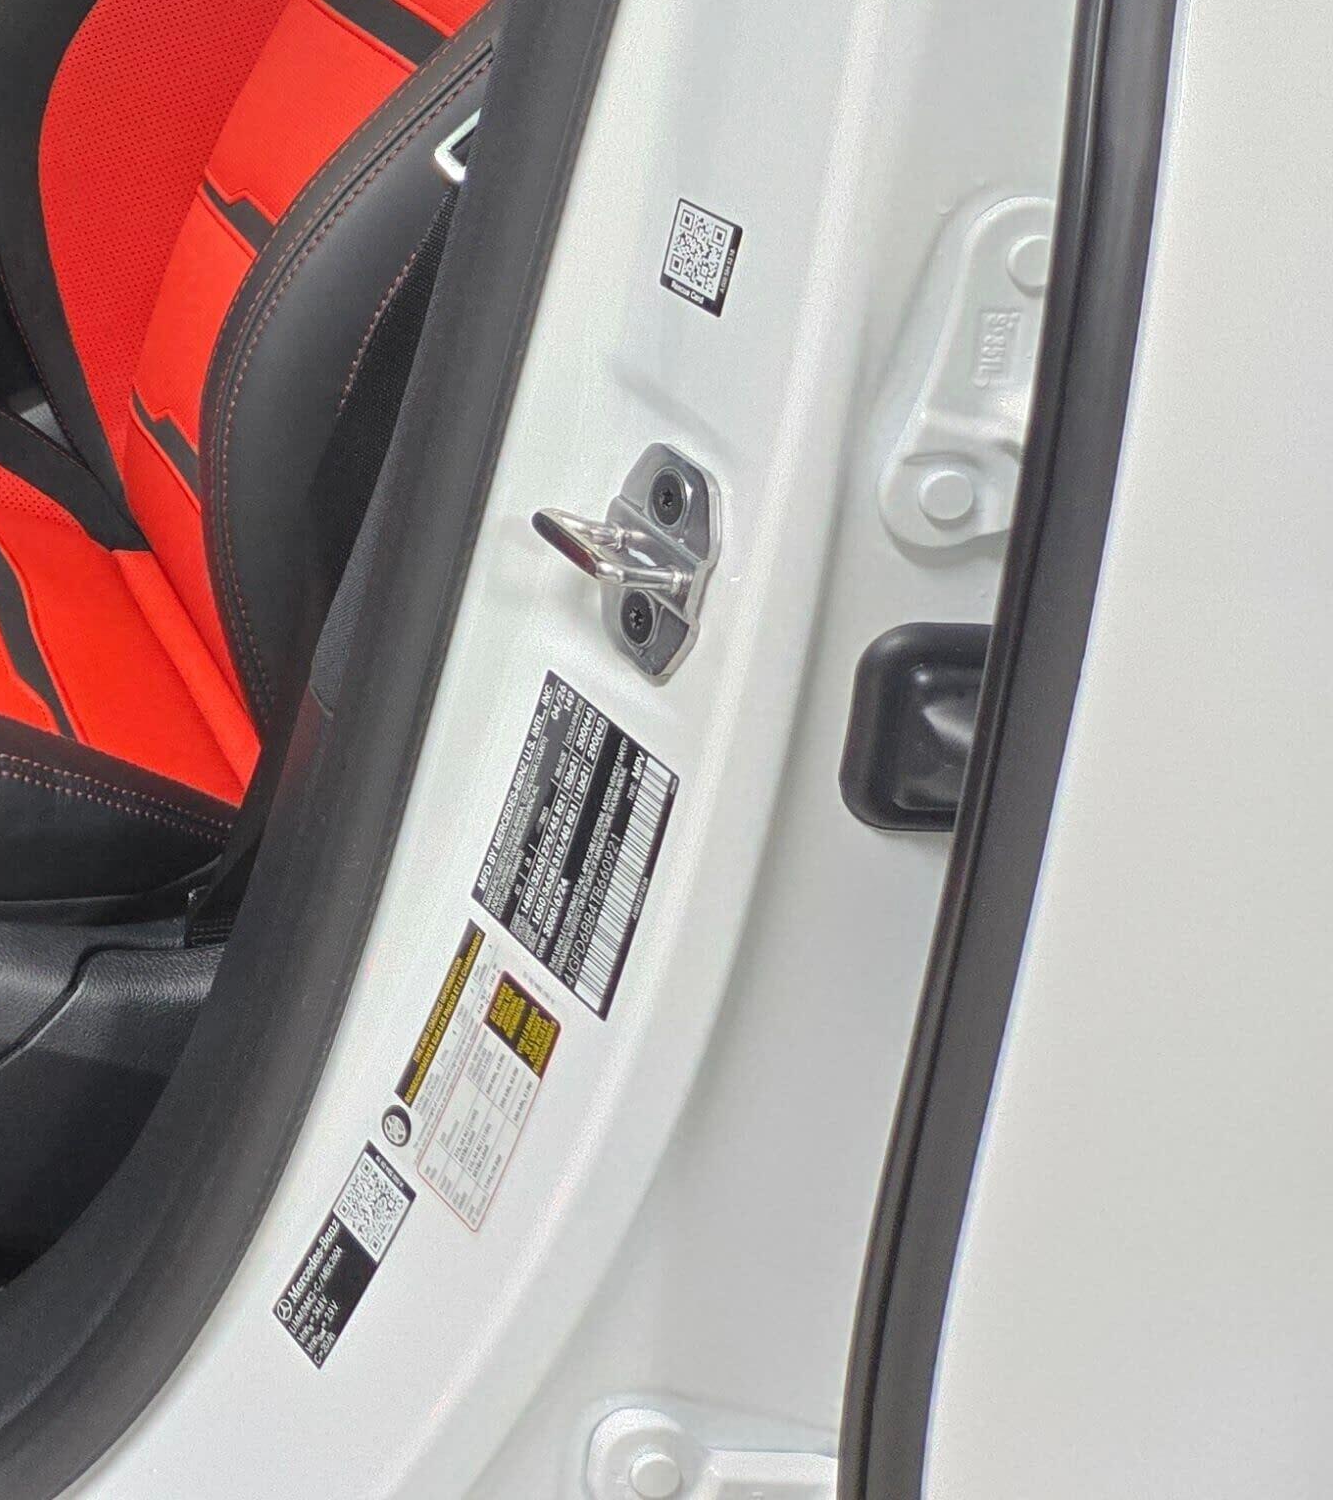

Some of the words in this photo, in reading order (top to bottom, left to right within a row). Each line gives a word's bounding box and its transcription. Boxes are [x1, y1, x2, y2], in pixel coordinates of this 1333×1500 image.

[549, 682, 568, 722] 04/26
[562, 688, 575, 713] 149
[522, 735, 536, 762] U.S.
[630, 749, 647, 780] MPV
[491, 757, 529, 851] MERCEDES-BENZ
[539, 812, 561, 858] 275/45
[553, 791, 567, 817] R21
[551, 822, 572, 869] 315/40
[565, 801, 578, 826] R21
[486, 846, 498, 866] BY
[529, 854, 546, 887] 3263
[477, 862, 493, 892] MFD
[552, 873, 569, 908] 6724
[520, 883, 536, 916] 1480
[531, 894, 547, 926] 1650
[562, 830, 621, 989] 4JGFD6BB4TB660921
[542, 904, 559, 939] 3050
[288, 1217, 340, 1304] Mercedes-Benz
